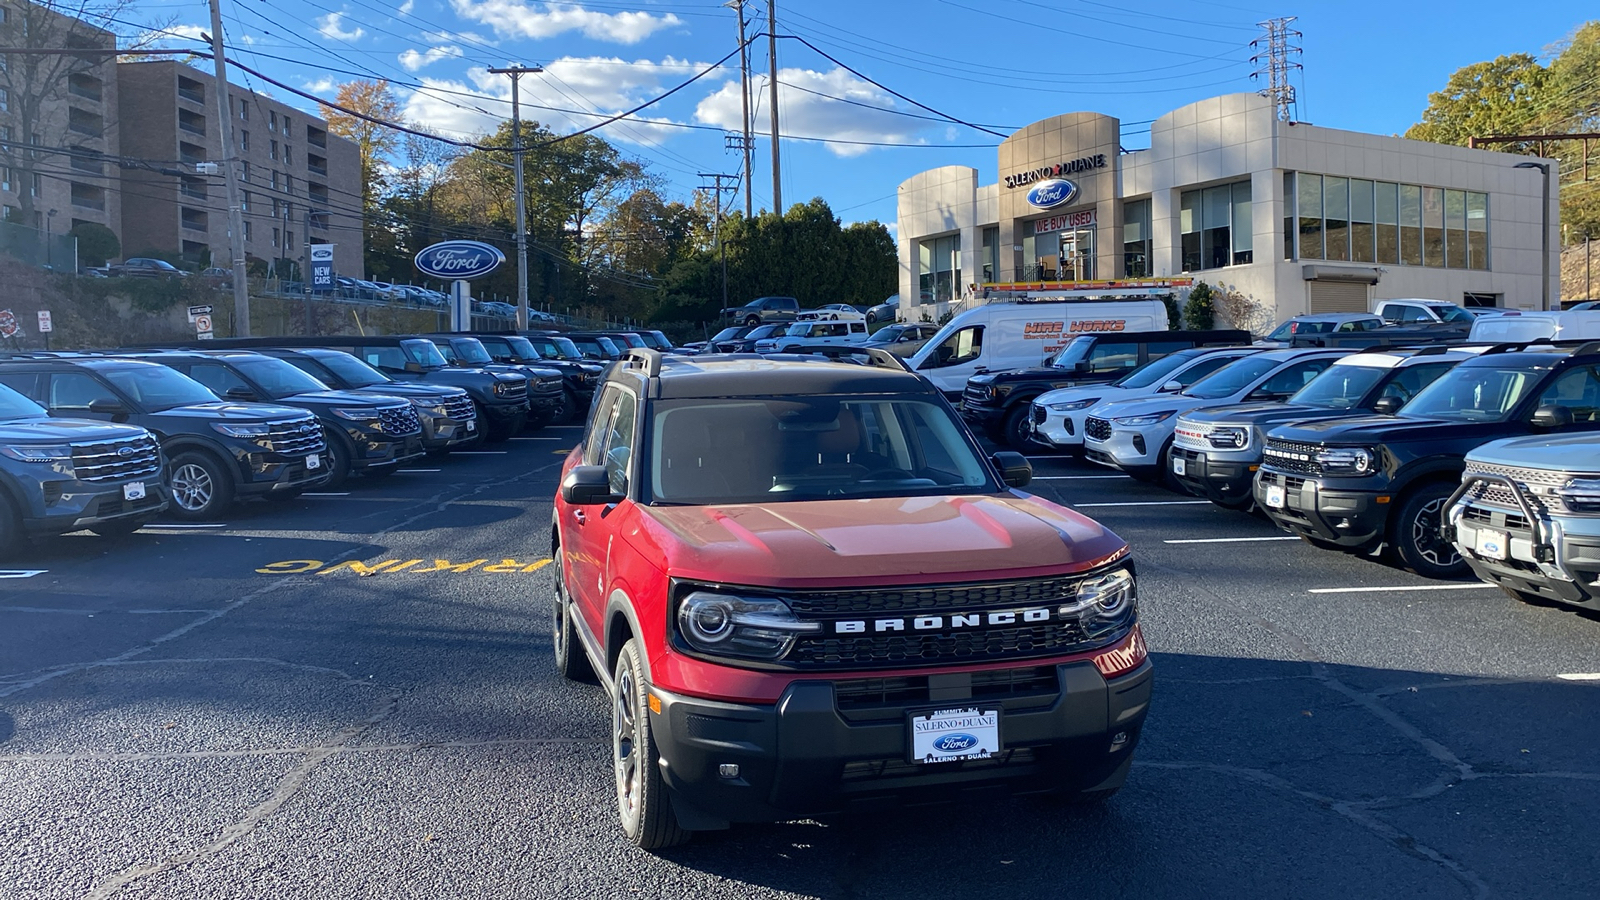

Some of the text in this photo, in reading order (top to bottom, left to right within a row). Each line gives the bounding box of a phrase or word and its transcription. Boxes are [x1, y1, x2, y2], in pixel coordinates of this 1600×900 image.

[1005, 154, 1106, 188] SALERNO DUANE
[1035, 185, 1062, 203] Ford
[1036, 219, 1048, 232] WE
[1051, 215, 1067, 230] BUY
[1070, 211, 1092, 227] USED
[431, 249, 481, 271] Ford
[315, 267, 330, 276] NEW
[1024, 320, 1126, 333] WIRE WORKS
[835, 608, 1050, 633] BRONCO
[915, 717, 995, 732] SALERNO DUANE
[941, 736, 970, 749] Ford
[923, 752, 992, 764] SALERNO DUANE
